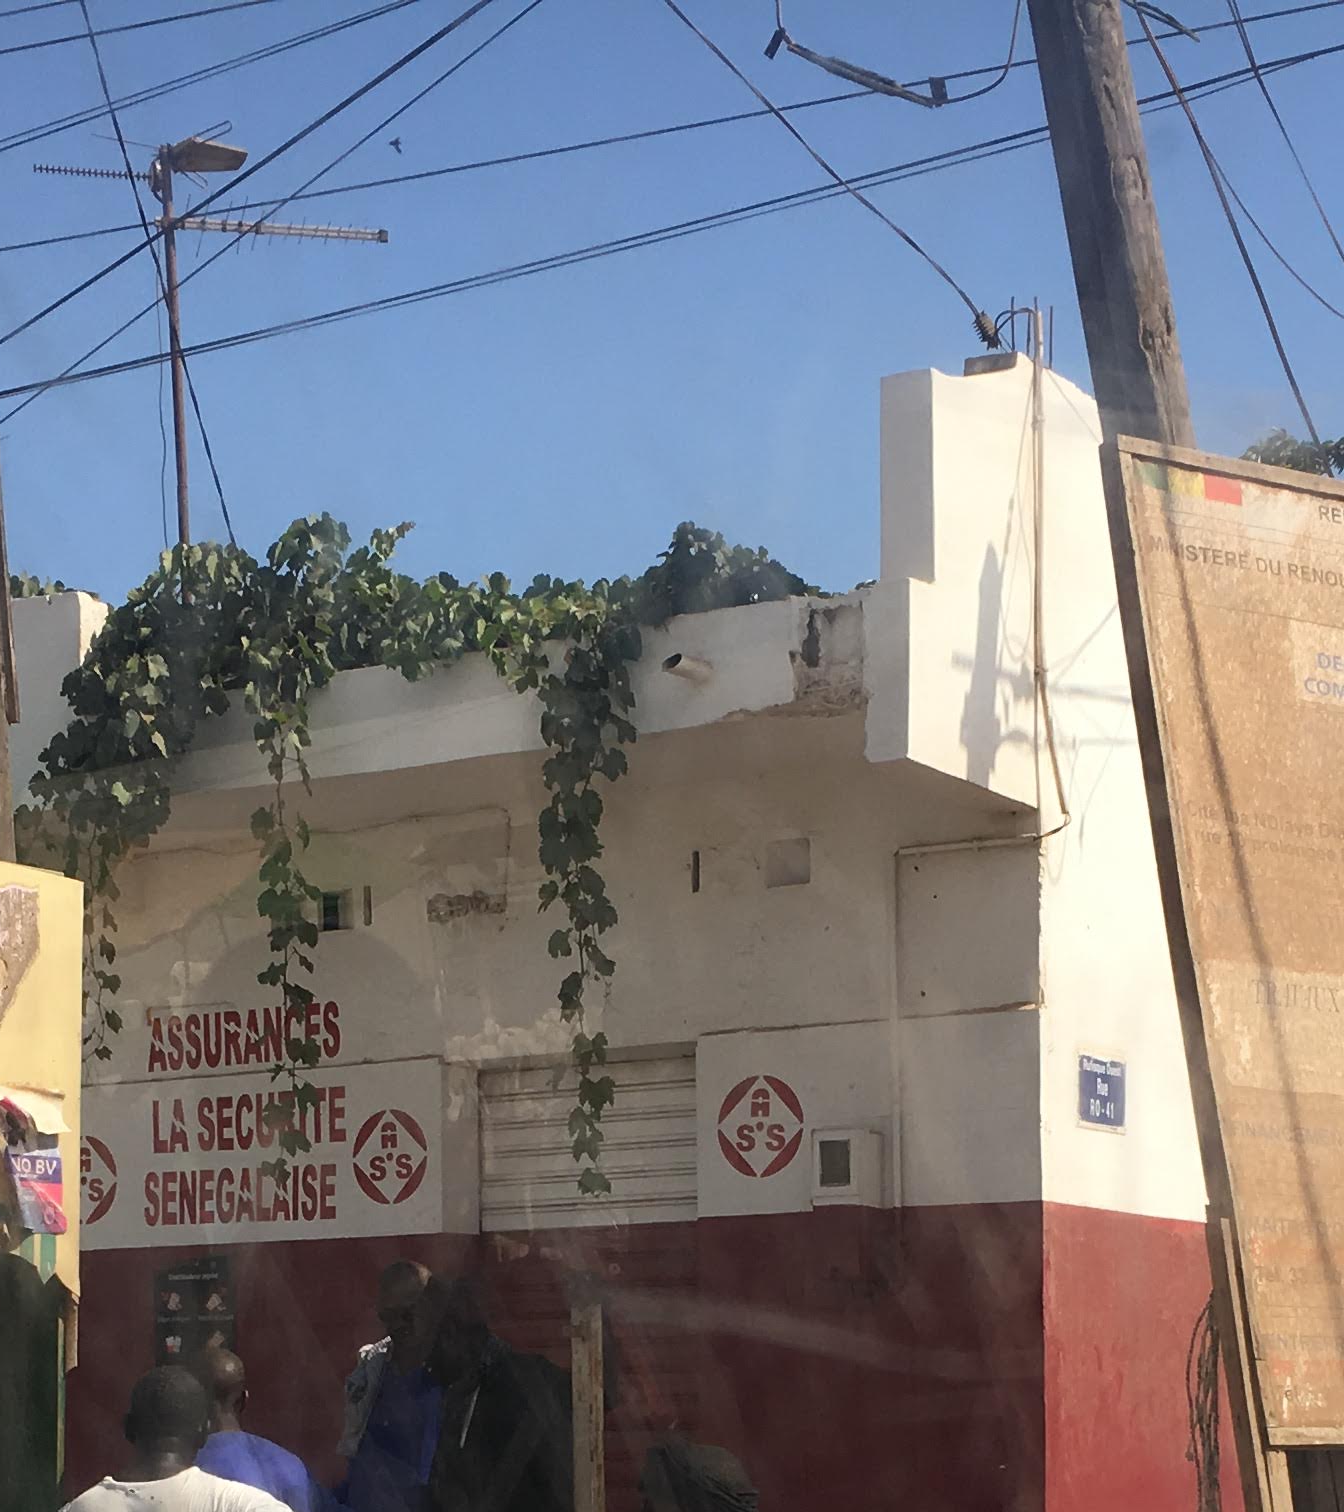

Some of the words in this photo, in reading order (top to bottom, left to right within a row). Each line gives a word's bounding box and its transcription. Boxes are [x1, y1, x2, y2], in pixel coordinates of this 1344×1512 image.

[1256, 556, 1282, 578] DU
[148, 1001, 341, 1073] ASSURANCES
[152, 1098, 189, 1154] LA
[144, 1163, 337, 1228] SENEGALAISE
